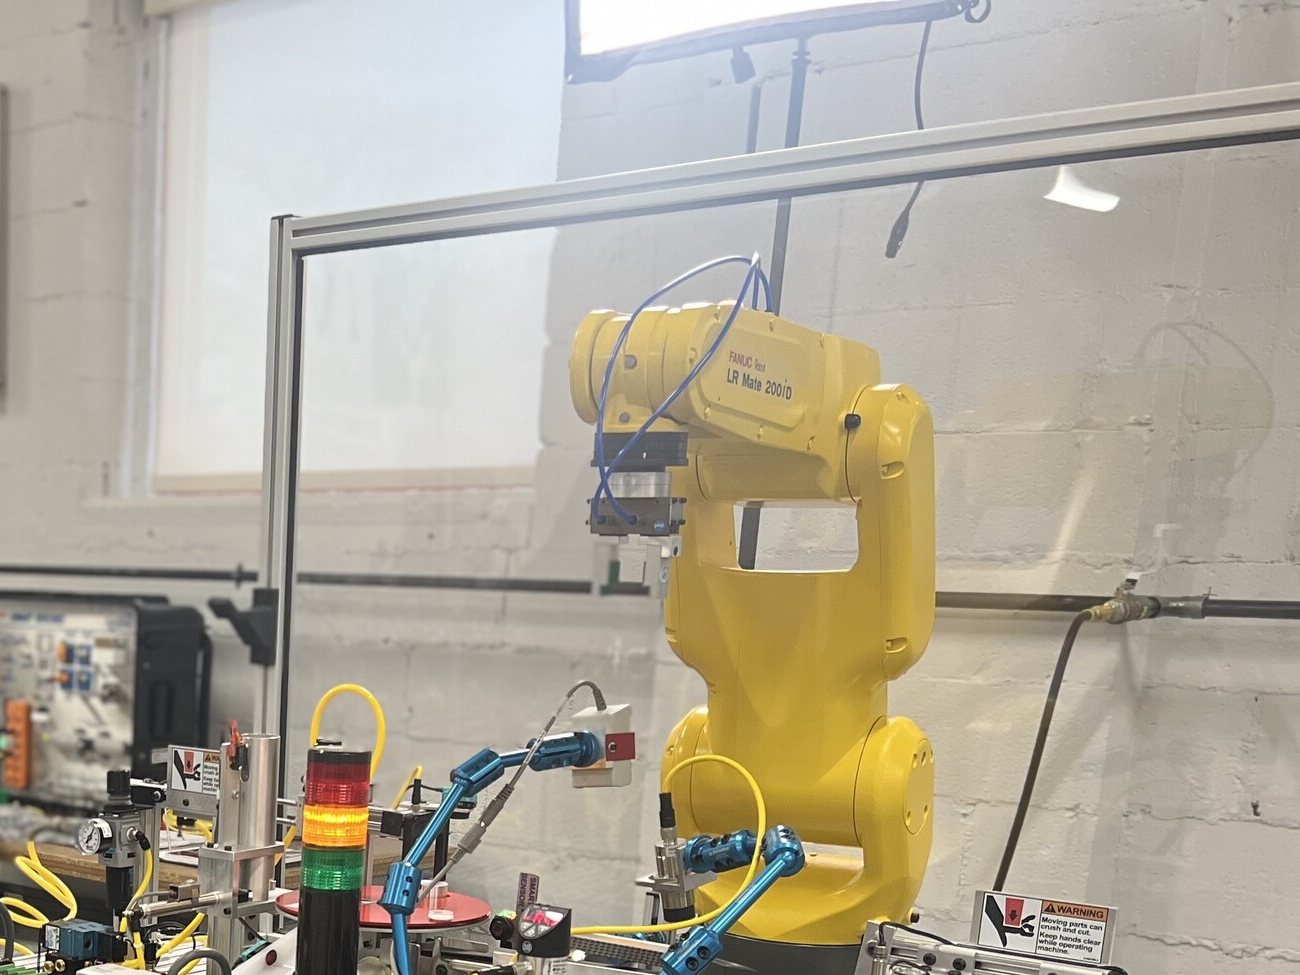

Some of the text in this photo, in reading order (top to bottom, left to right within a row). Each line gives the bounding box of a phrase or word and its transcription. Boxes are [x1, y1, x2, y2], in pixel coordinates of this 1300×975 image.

[729, 350, 753, 369] FANUC
[727, 368, 792, 400] LR Mate 200iD
[1057, 905, 1104, 919] WARNING
[1040, 924, 1061, 932] crush
[1041, 916, 1068, 927] Moving
[1069, 921, 1088, 929] parts
[1038, 938, 1093, 953] while operating
[1039, 932, 1101, 946] Keep hands clear
[1037, 945, 1070, 955] machine.
